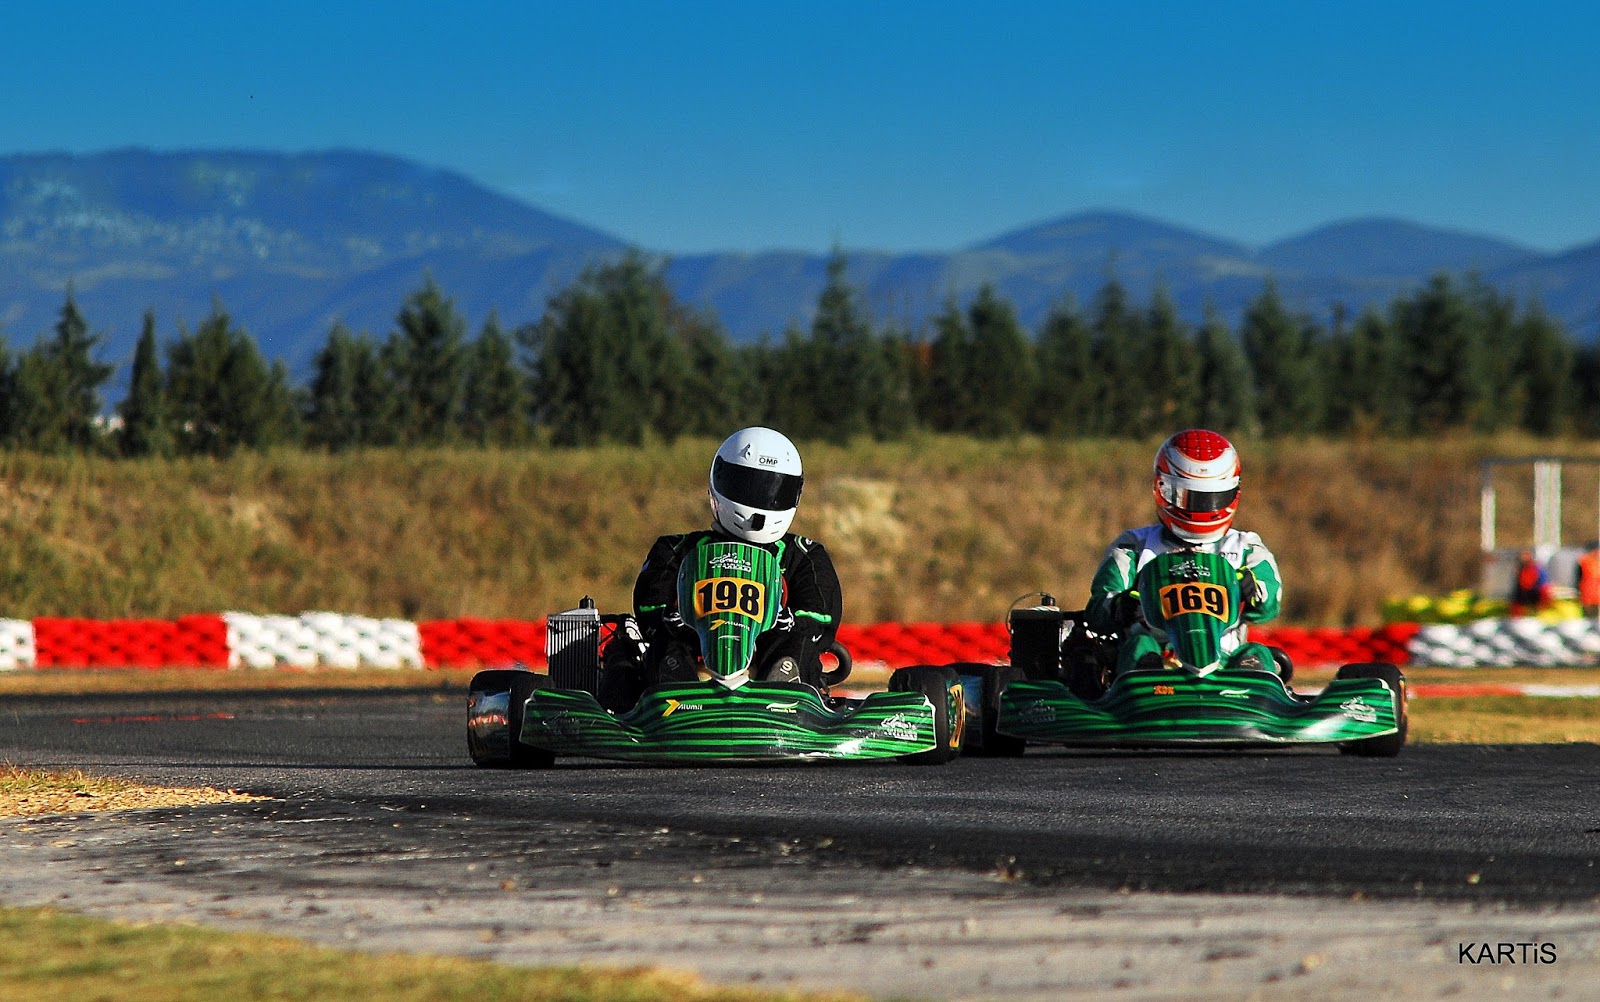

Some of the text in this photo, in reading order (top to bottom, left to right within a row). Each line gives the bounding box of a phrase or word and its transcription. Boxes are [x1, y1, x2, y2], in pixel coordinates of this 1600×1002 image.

[758, 456, 779, 466] OMP
[697, 580, 760, 616] 198
[1163, 585, 1224, 616] 169
